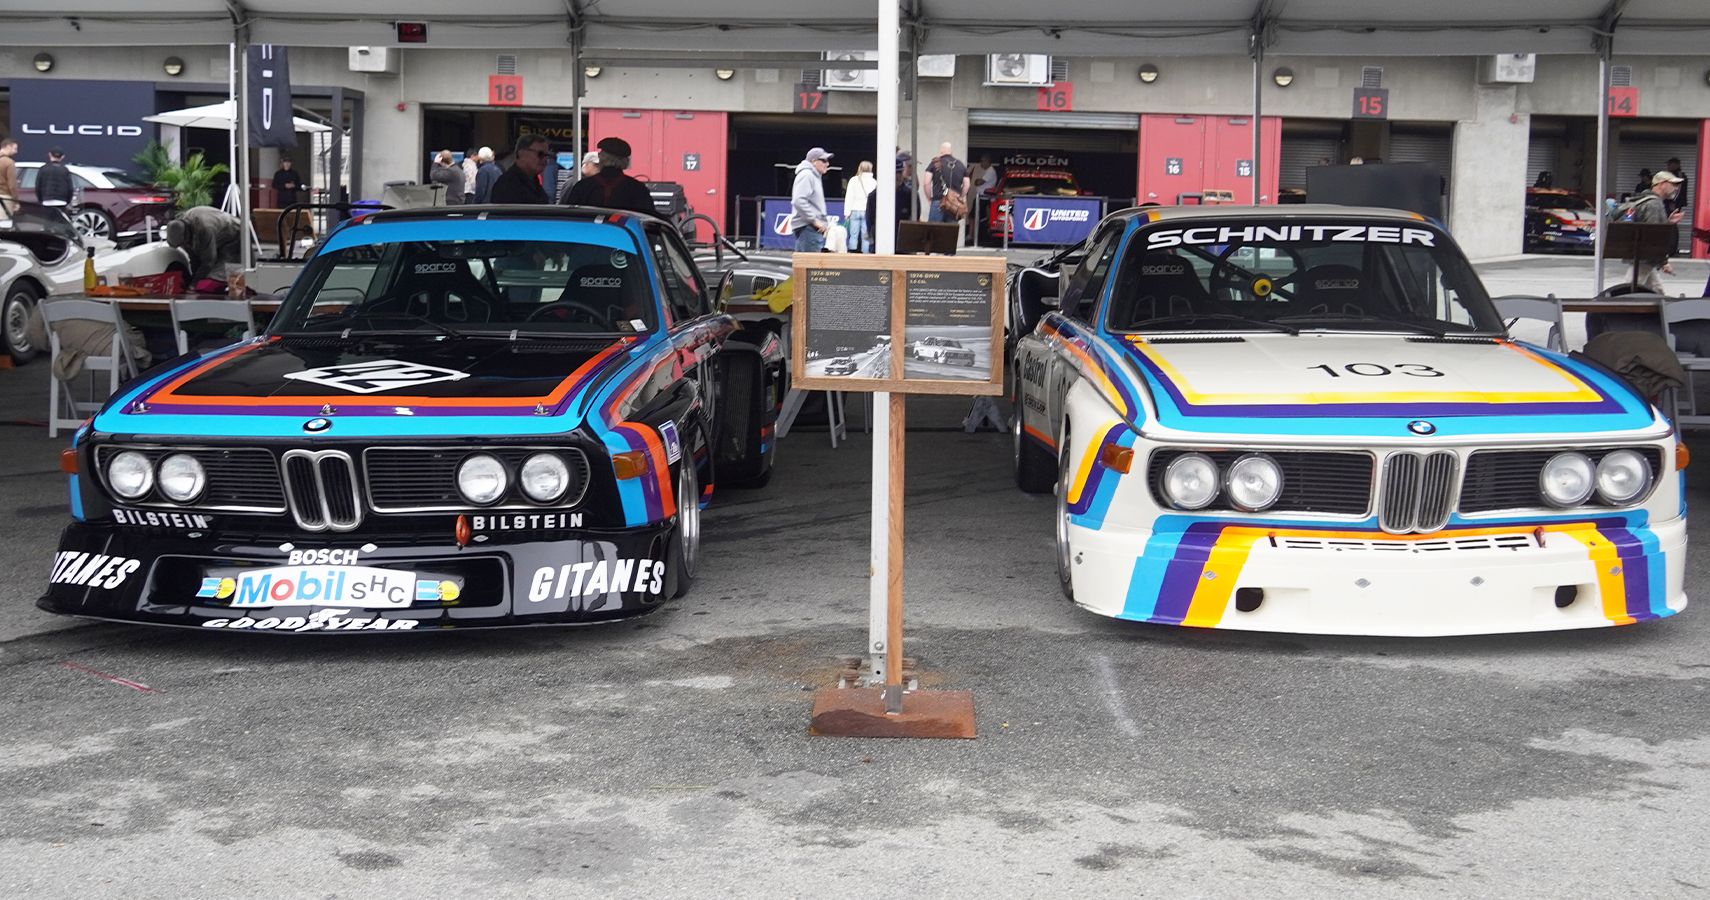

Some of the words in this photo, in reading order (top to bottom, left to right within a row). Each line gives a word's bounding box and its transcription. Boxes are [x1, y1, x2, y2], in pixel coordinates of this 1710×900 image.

[495, 84, 516, 101] 18
[800, 92, 822, 110] 17
[1045, 90, 1066, 108] 16
[1359, 97, 1382, 114] 15
[1609, 96, 1632, 113] 14
[22, 123, 142, 136] LUCID
[685, 160, 697, 170] 17
[1003, 156, 1069, 166] HOLDEN
[1168, 164, 1180, 174] 16
[1051, 209, 1090, 217] UNITED
[1147, 225, 1436, 250] SCHNITZER
[415, 262, 457, 274] sparco
[580, 276, 622, 287] sparco
[314, 364, 455, 389] 42
[1306, 363, 1446, 377] 103
[112, 509, 208, 528] BILSTEIN
[473, 513, 583, 530] BILSTEIN
[288, 549, 359, 565] BOSCH
[51, 551, 141, 590] ITANES
[237, 570, 346, 605] Mobil
[351, 575, 405, 604] SHC
[529, 559, 665, 602] GITANES
[202, 615, 419, 632] GOODYEAR
